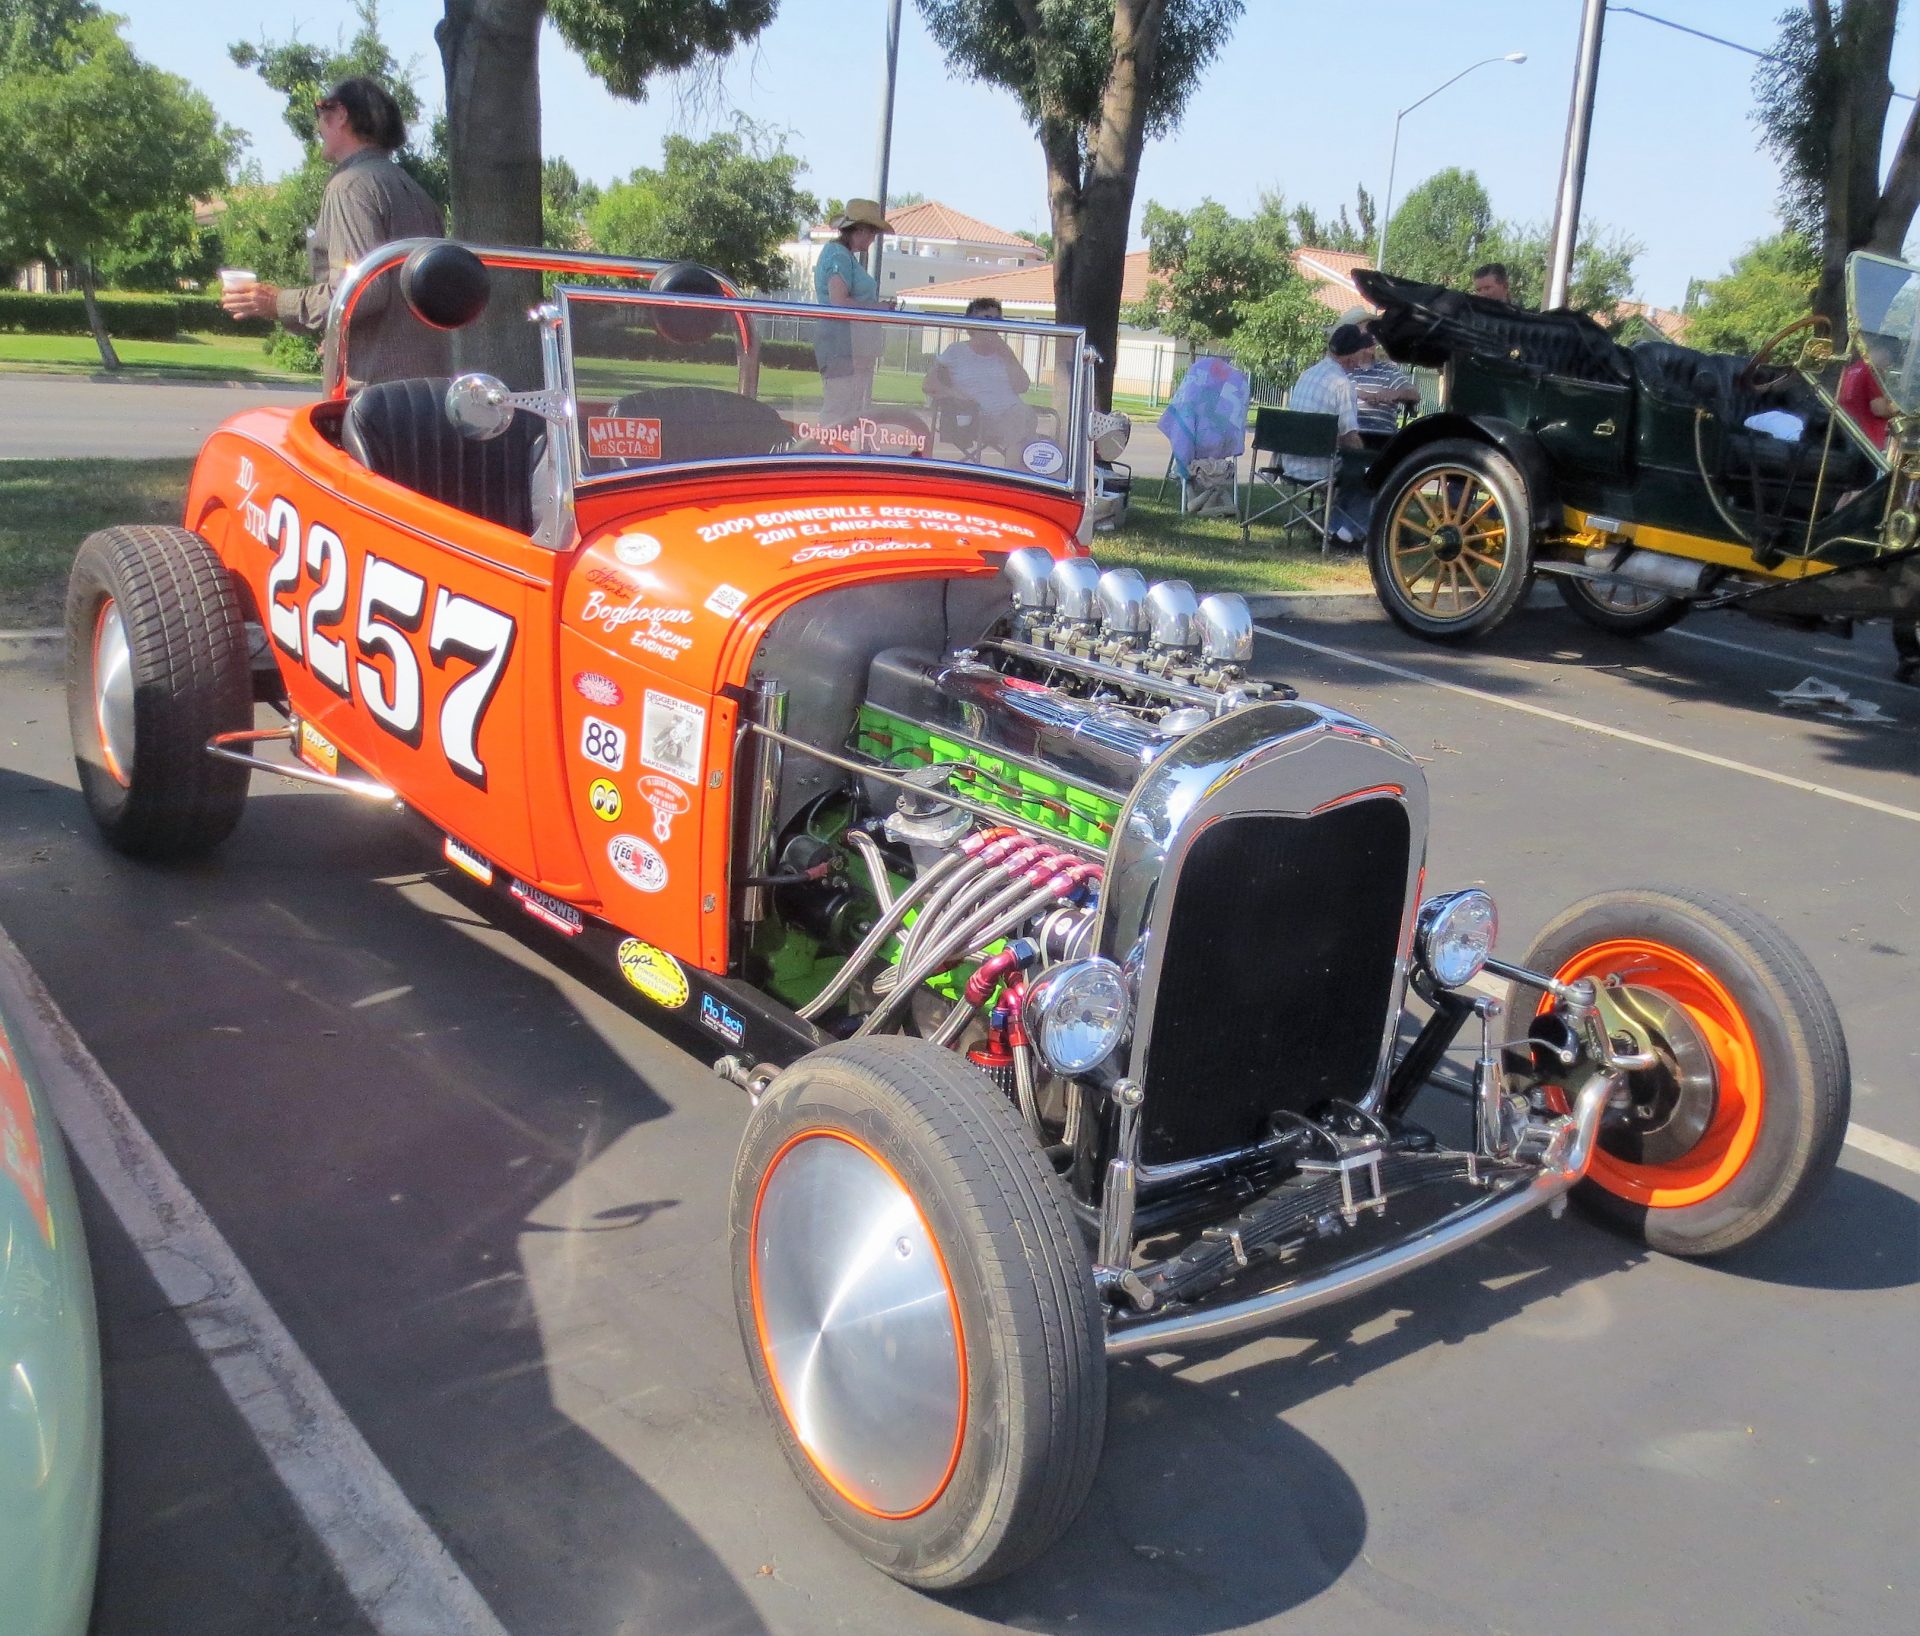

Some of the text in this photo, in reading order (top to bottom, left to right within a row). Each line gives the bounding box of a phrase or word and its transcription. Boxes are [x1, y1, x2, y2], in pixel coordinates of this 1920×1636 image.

[591, 421, 658, 444] MILERS
[608, 441, 642, 454] SCTA
[799, 422, 858, 446] Crippled
[880, 428, 926, 451] Racing
[245, 501, 268, 546] STR
[697, 517, 754, 543] 2009
[755, 506, 875, 528] BONNEVILLE
[879, 506, 962, 522] RECORD
[754, 527, 797, 546] 2011
[800, 524, 829, 537] EL
[830, 520, 914, 533] MIRAGE
[792, 540, 932, 562] Tony Waters
[581, 591, 694, 633] Boghosian
[267, 494, 518, 793] 2257
[630, 630, 679, 661] ENGINES
[586, 722, 617, 764] 88
[512, 878, 580, 925] AUTOPOWER
[622, 943, 658, 970] Caps
[703, 994, 719, 1019] Pro
[721, 1006, 743, 1035] Tech
